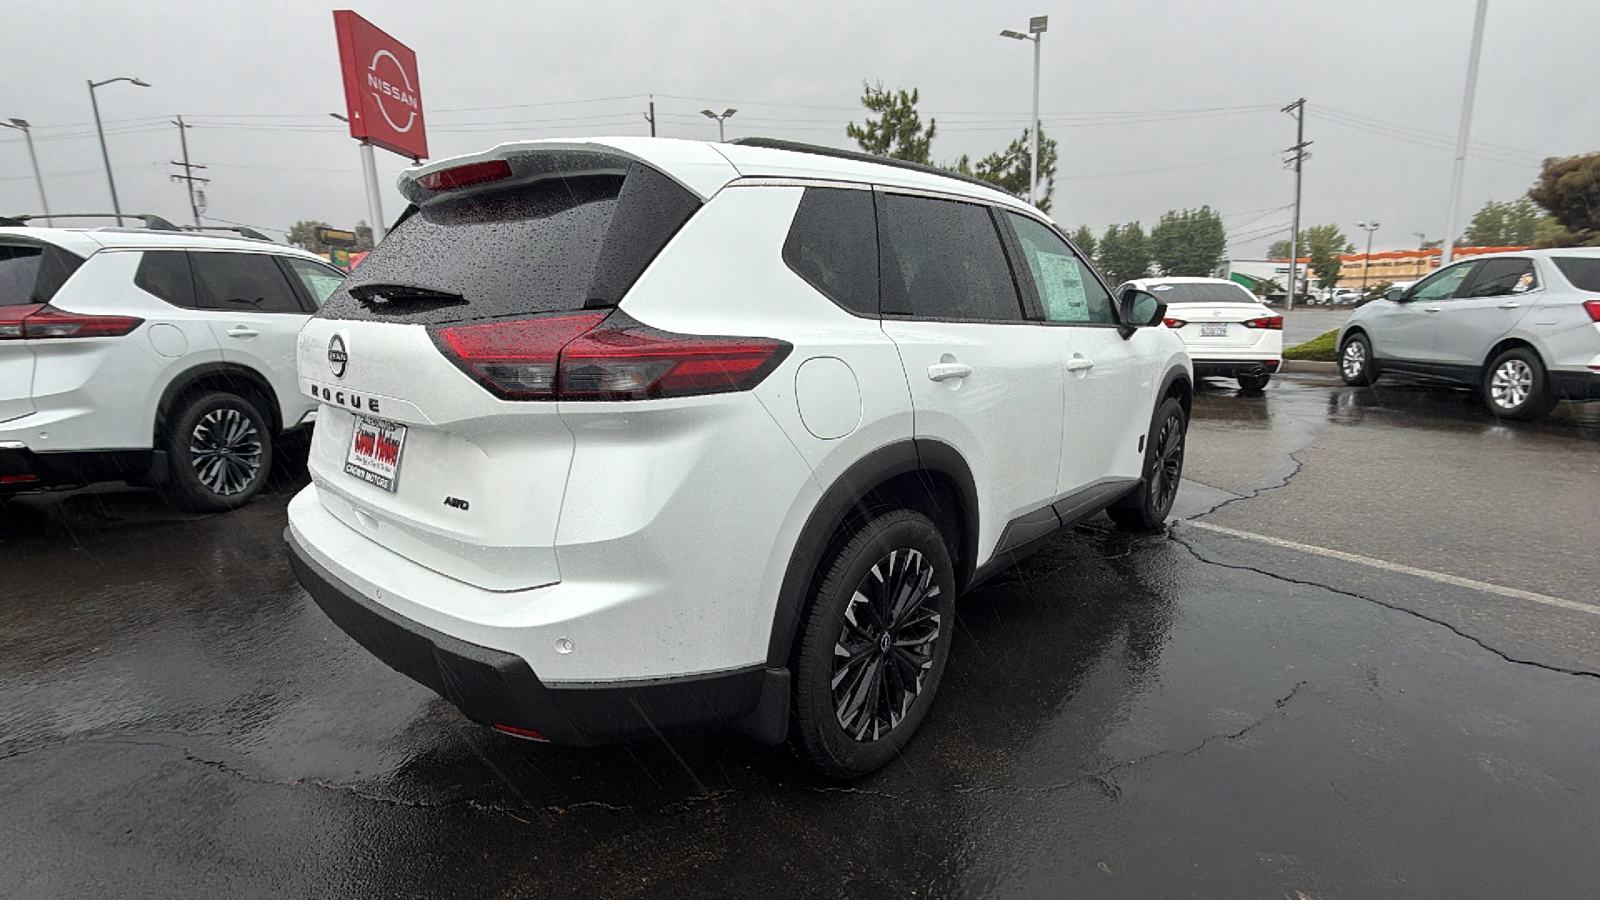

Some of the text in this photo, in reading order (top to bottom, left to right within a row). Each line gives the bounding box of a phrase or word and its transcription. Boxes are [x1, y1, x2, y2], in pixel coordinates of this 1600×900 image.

[368, 73, 417, 109] NISSAN
[311, 384, 380, 412] ROGUE
[346, 464, 389, 489] CROWN MOTORS
[443, 496, 469, 511] AWD
